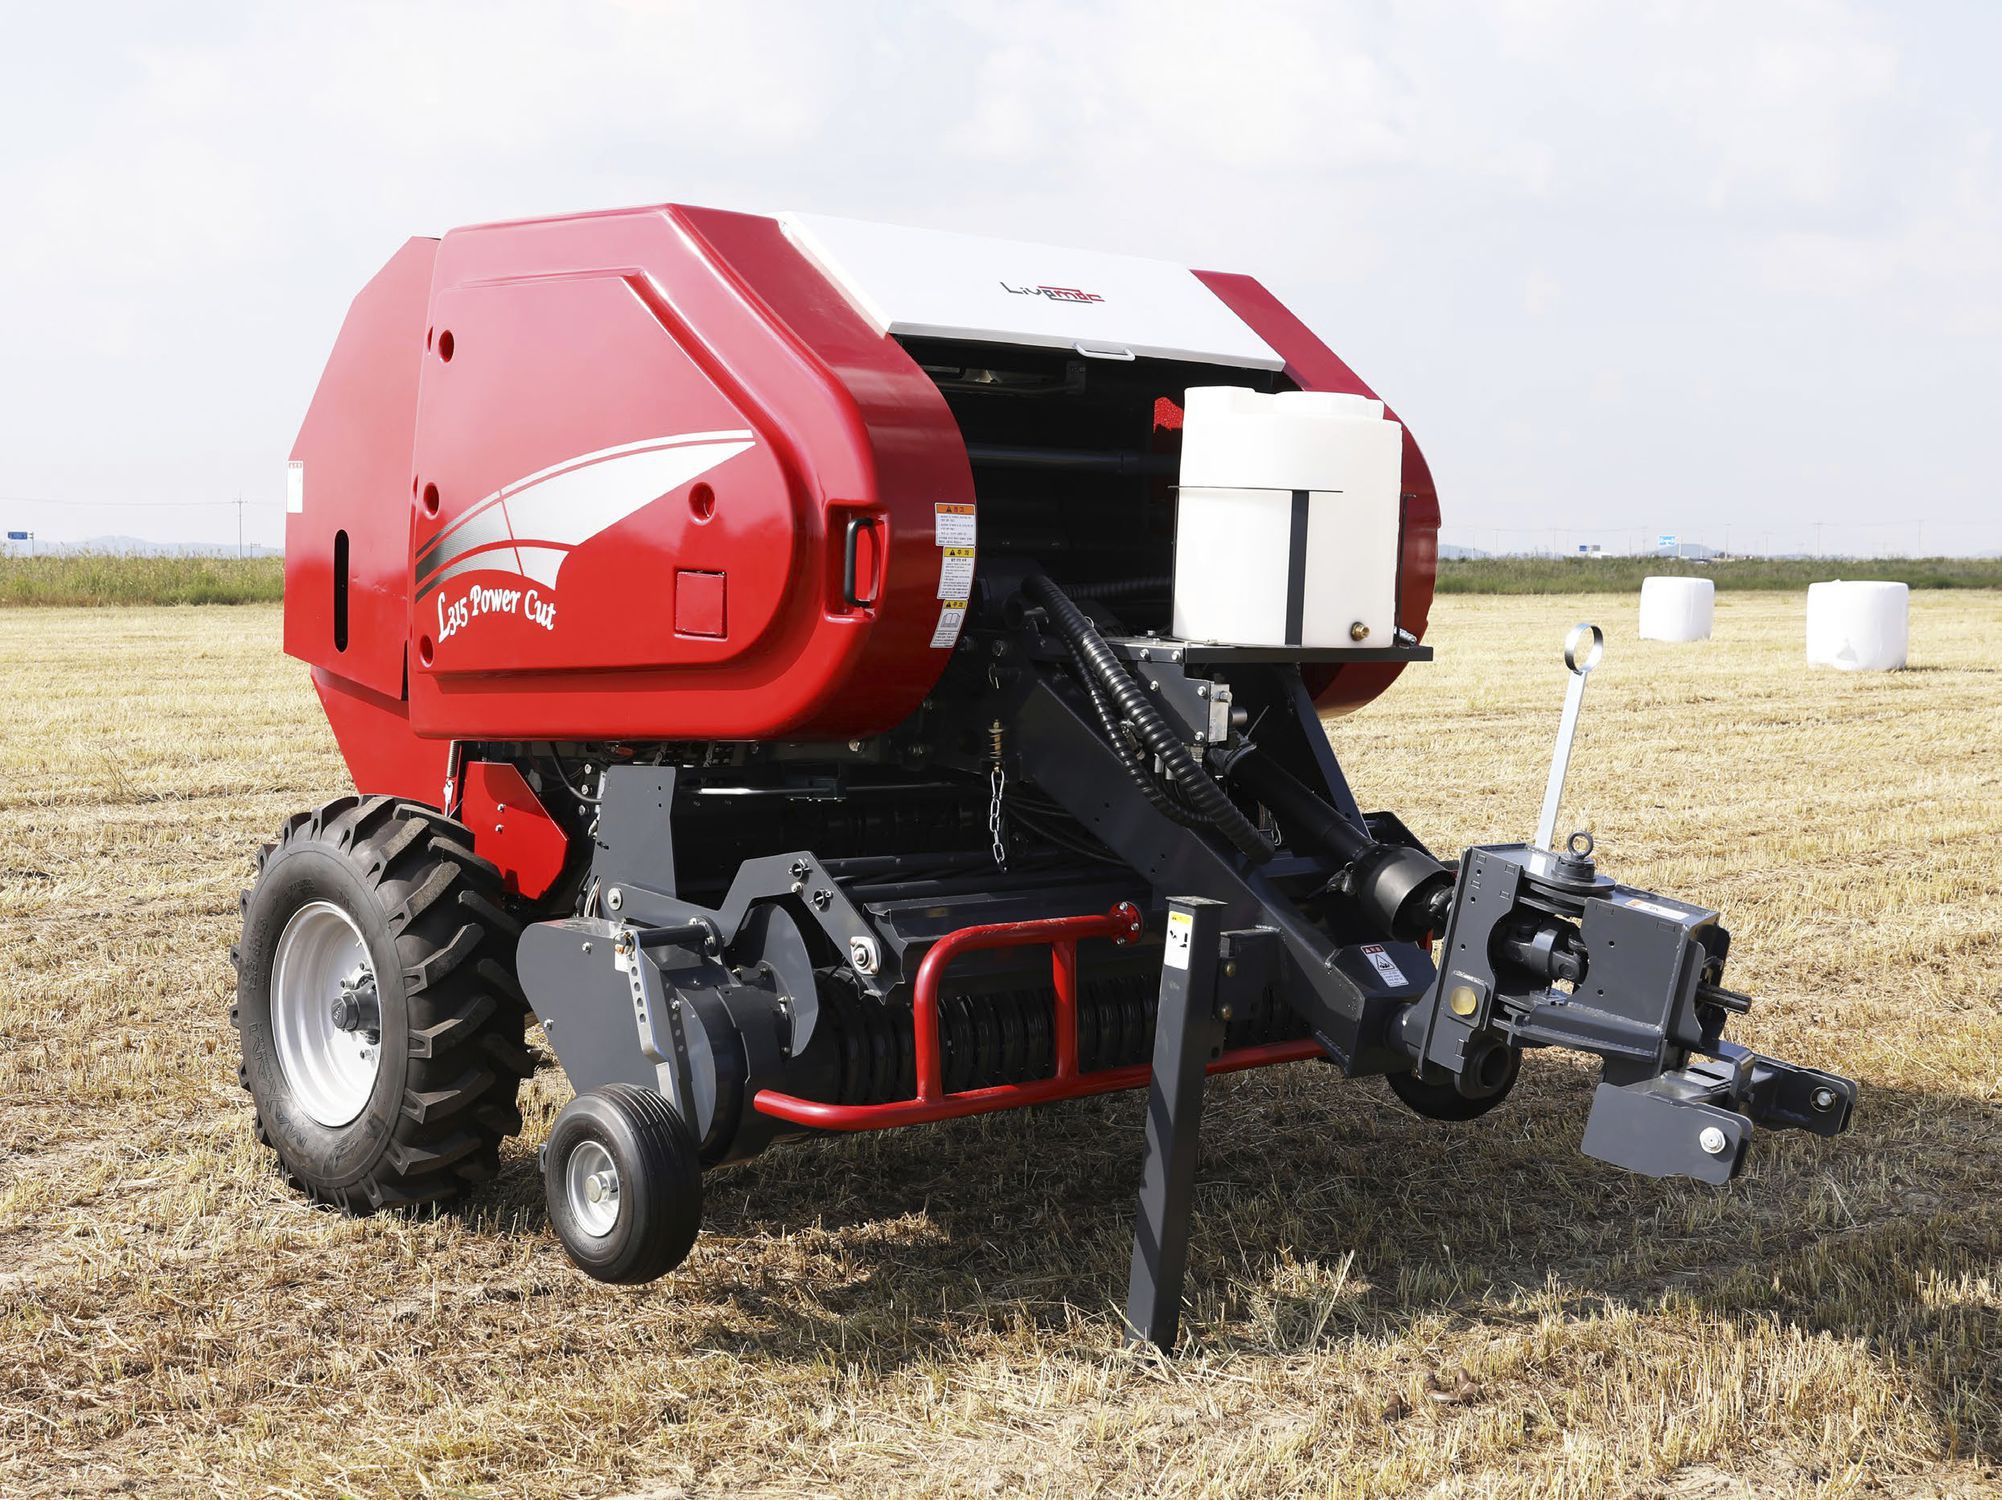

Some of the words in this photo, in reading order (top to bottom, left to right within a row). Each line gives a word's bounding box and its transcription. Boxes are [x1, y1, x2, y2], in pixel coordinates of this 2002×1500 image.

[438, 592, 468, 643] L315
[470, 585, 521, 616] Power
[524, 589, 556, 630] Cut
